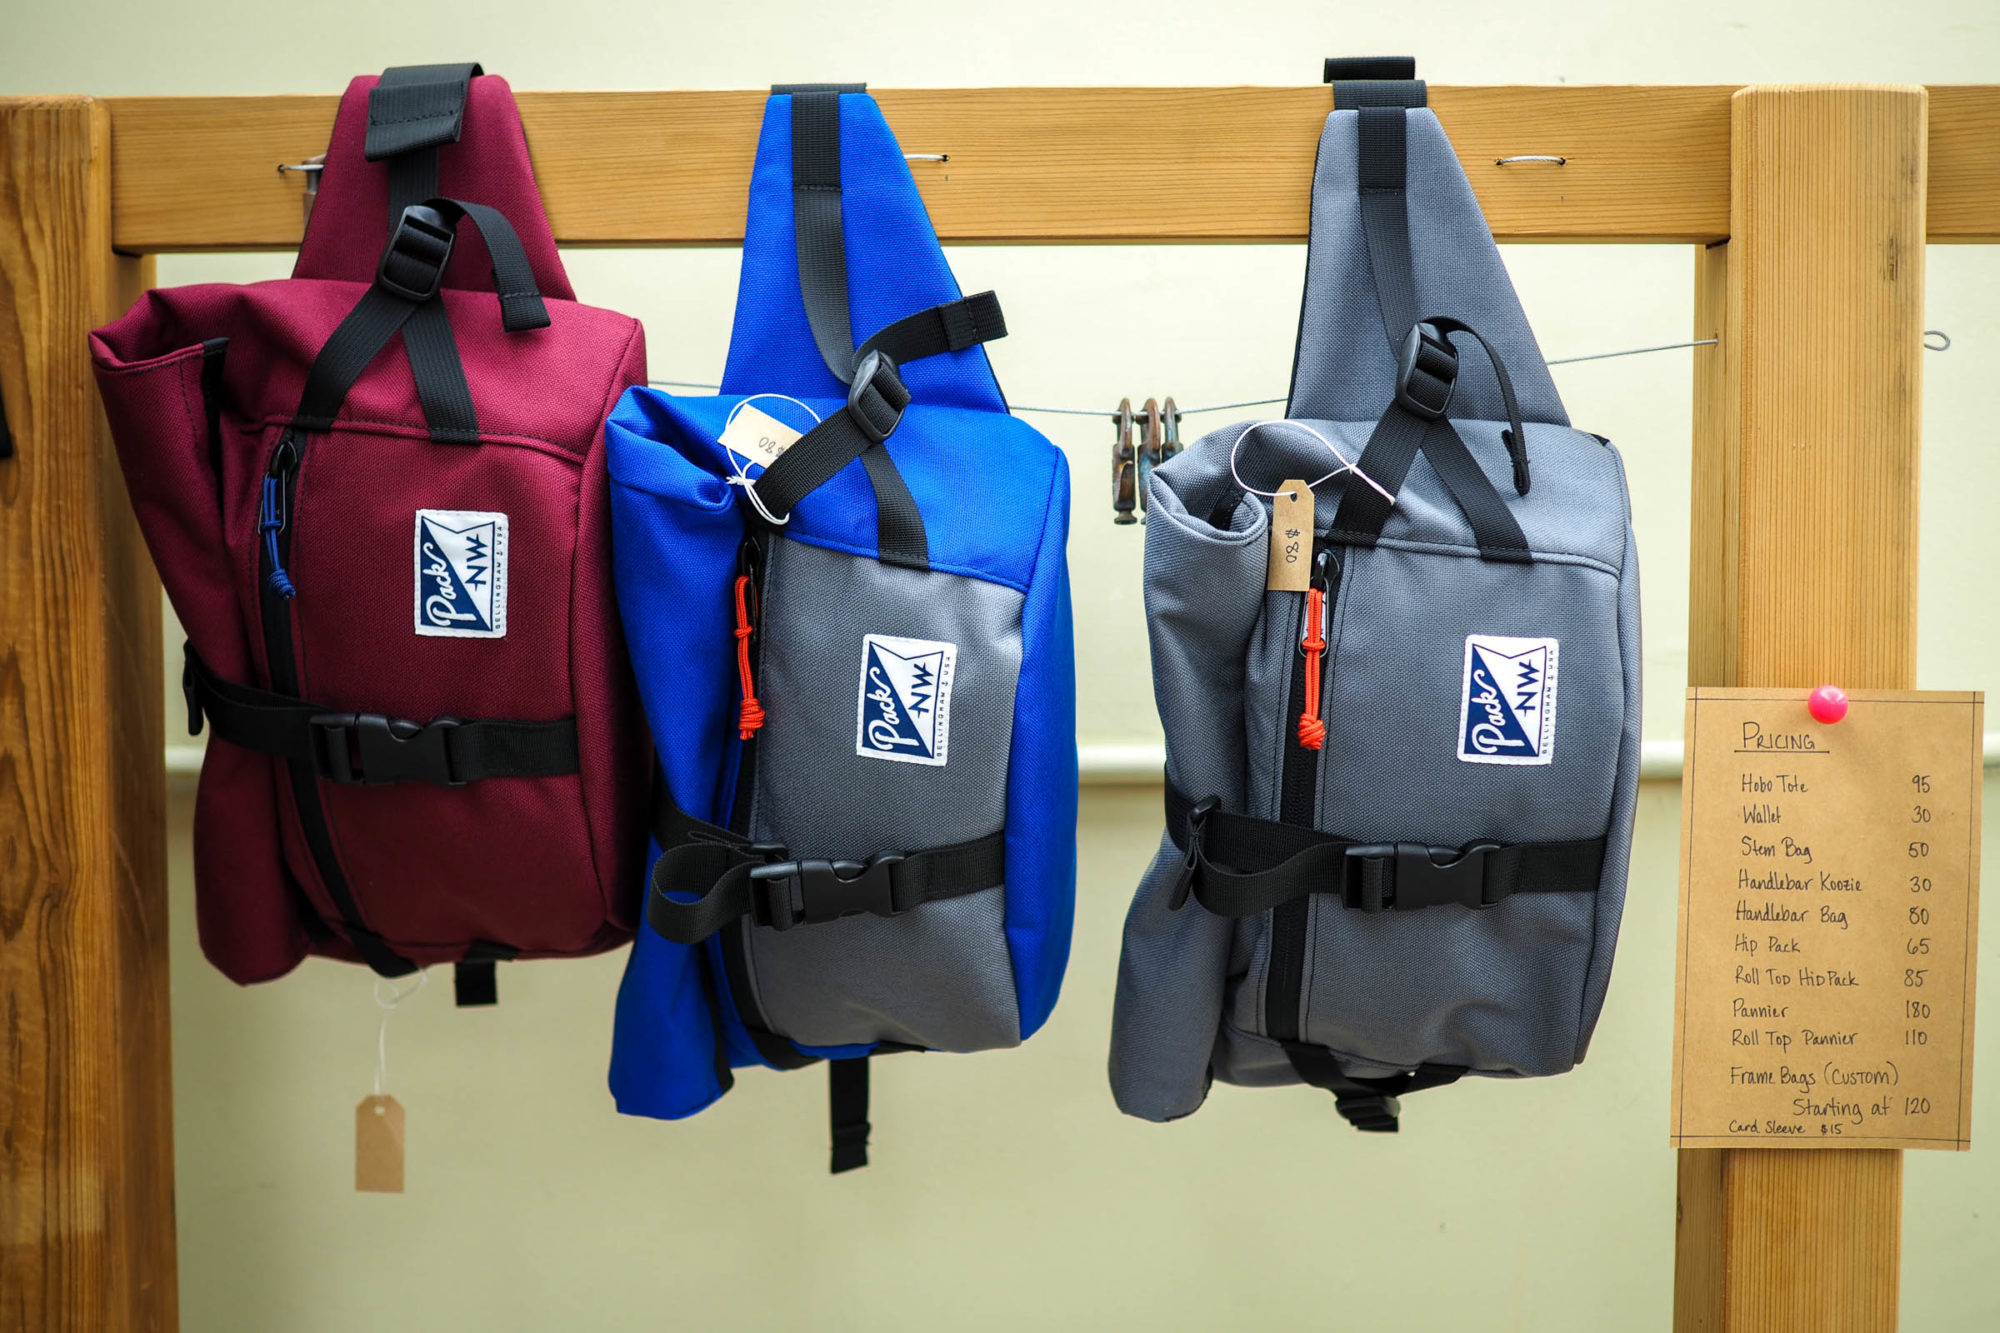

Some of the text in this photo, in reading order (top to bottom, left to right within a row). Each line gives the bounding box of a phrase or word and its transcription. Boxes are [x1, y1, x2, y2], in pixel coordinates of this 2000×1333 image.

[1285, 528, 1301, 563] $80
[465, 533, 489, 592] NW
[908, 662, 934, 719] NW
[1514, 659, 1540, 717] NW
[936, 656, 951, 758] BELLINGHAM USA
[1541, 686, 1551, 754] BELLINGHAM
[1742, 773, 1931, 794] Hobo Tote 95
[1743, 803, 1931, 824] Wallet 30
[1741, 835, 1929, 864] Stem Bag 50
[1738, 868, 1932, 893] Handlebar Koozie 30
[1736, 900, 1809, 922] Handlebar
[1820, 905, 1848, 930] Bag
[1735, 933, 1931, 957] Hip Pack 65
[1735, 965, 1760, 985] Roll
[1903, 968, 1928, 987] 85
[1733, 997, 1931, 1019] Pannier 180
[1732, 1028, 1927, 1054] Roll Top Pannier 110
[1731, 1066, 1776, 1085] Frame
[1780, 1065, 1816, 1093] Bags
[1793, 1096, 1931, 1125] Starting at 120
[1728, 1120, 1844, 1135] Card Sleeve $15
